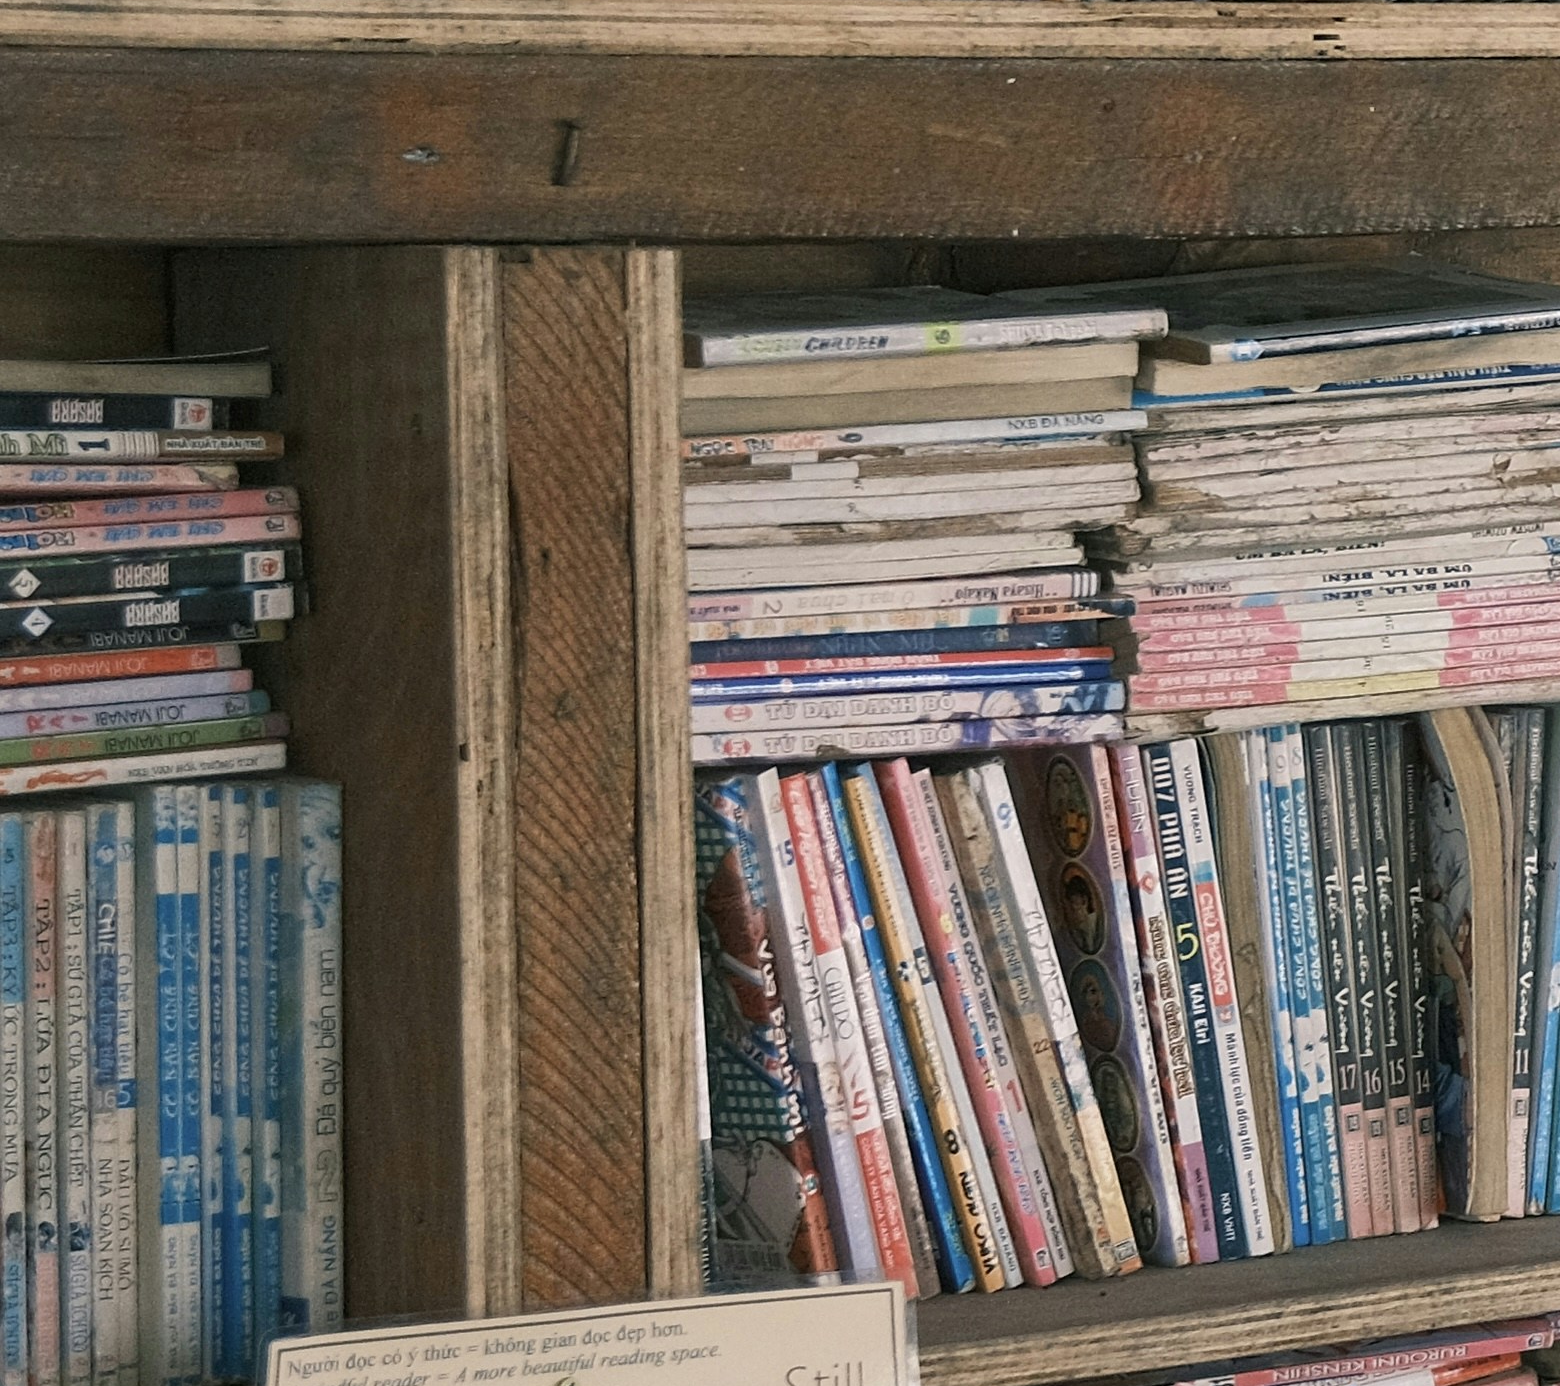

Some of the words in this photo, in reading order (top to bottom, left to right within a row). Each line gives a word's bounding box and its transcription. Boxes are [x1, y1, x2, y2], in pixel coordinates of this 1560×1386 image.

[166, 436, 188, 451] NHÀ
[191, 435, 218, 451] XUẤT
[289, 1356, 340, 1380] Người
[345, 1348, 375, 1370] đọc
[382, 1348, 402, 1365] có
[409, 1350, 420, 1366] ý
[424, 1343, 462, 1361] thức
[485, 1337, 536, 1357] không
[542, 1332, 577, 1353] gian
[582, 1328, 611, 1348] đọc
[616, 1324, 646, 1344] đẹp
[652, 1321, 688, 1339] hơn.
[454, 1368, 466, 1384] A
[473, 1366, 516, 1381] more
[522, 1353, 595, 1377] beautiful
[601, 1346, 665, 1368] reading
[670, 1344, 722, 1364] space.
